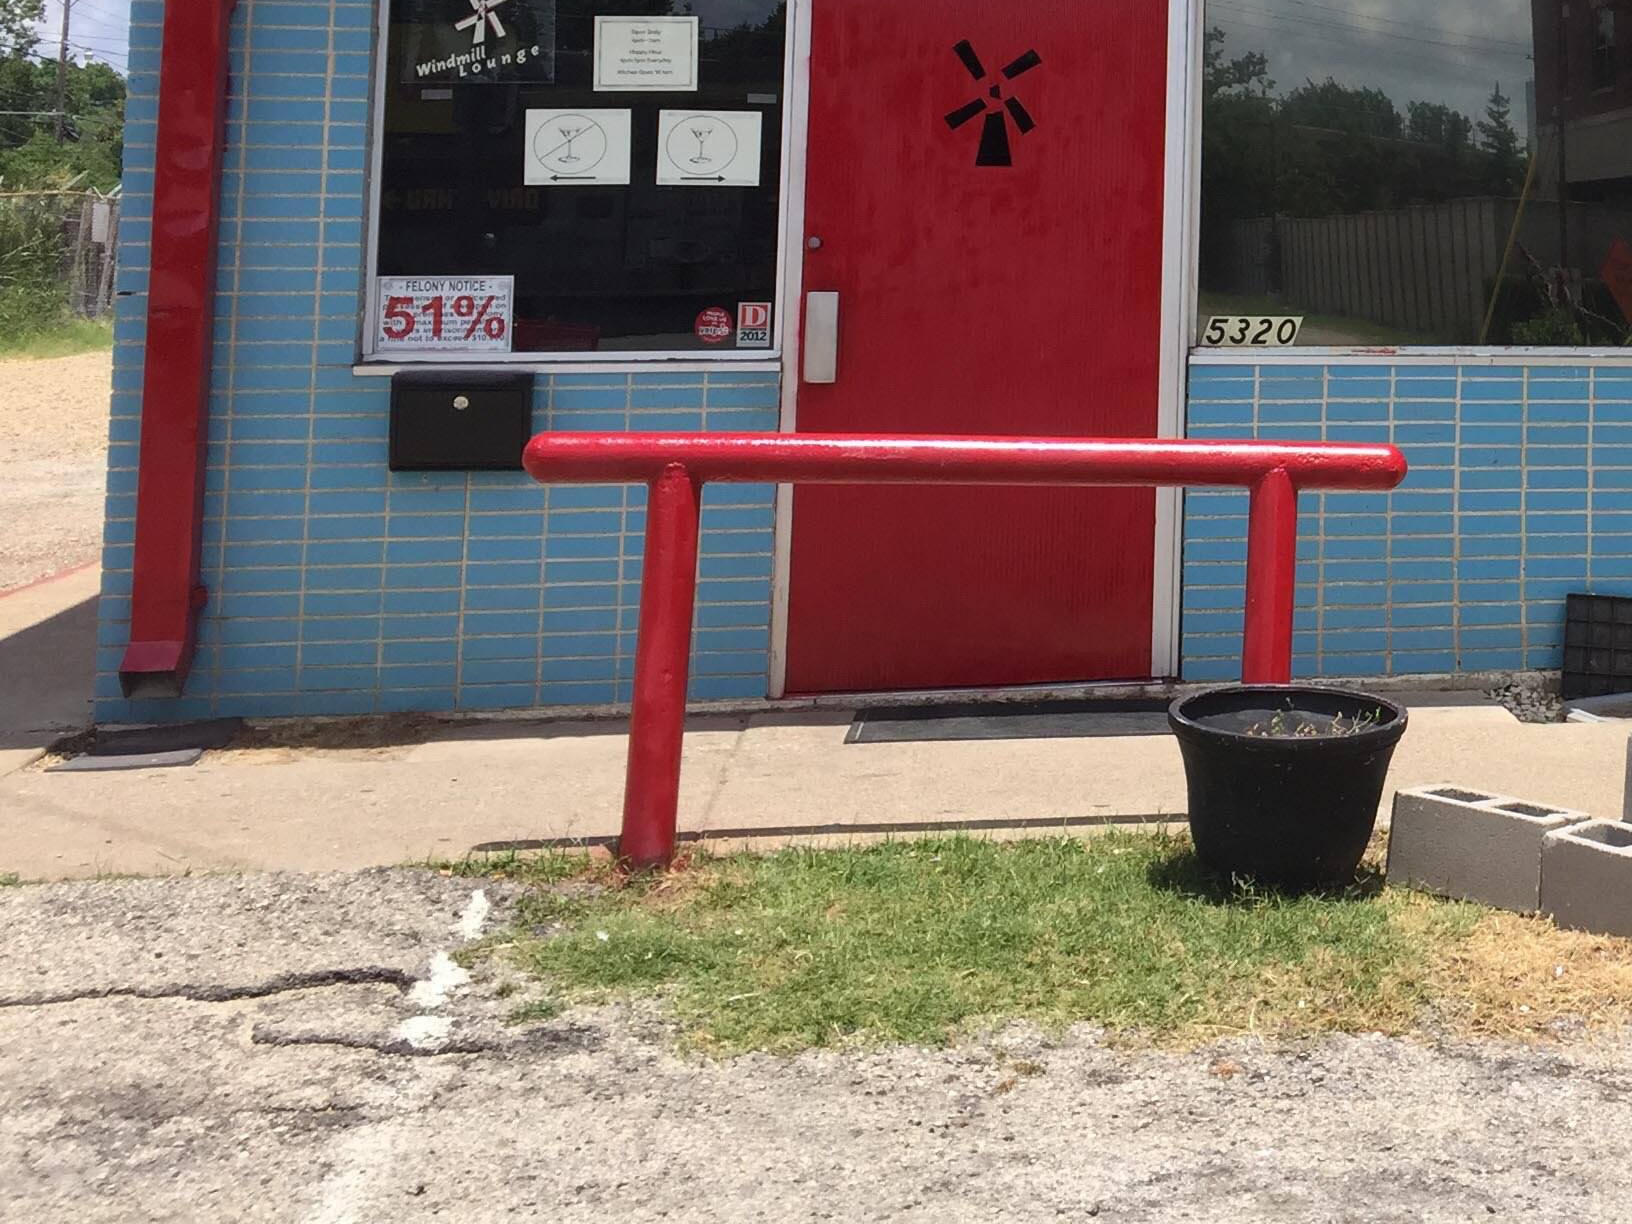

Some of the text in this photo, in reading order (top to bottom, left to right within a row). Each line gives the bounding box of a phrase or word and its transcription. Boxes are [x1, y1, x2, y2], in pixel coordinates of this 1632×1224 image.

[416, 45, 486, 77] Windmill
[459, 45, 540, 77] Lounge
[405, 280, 486, 292] FELONY NOTICE
[383, 294, 506, 341] 51%
[1206, 318, 1296, 344] 5320
[740, 331, 767, 342] 2012
